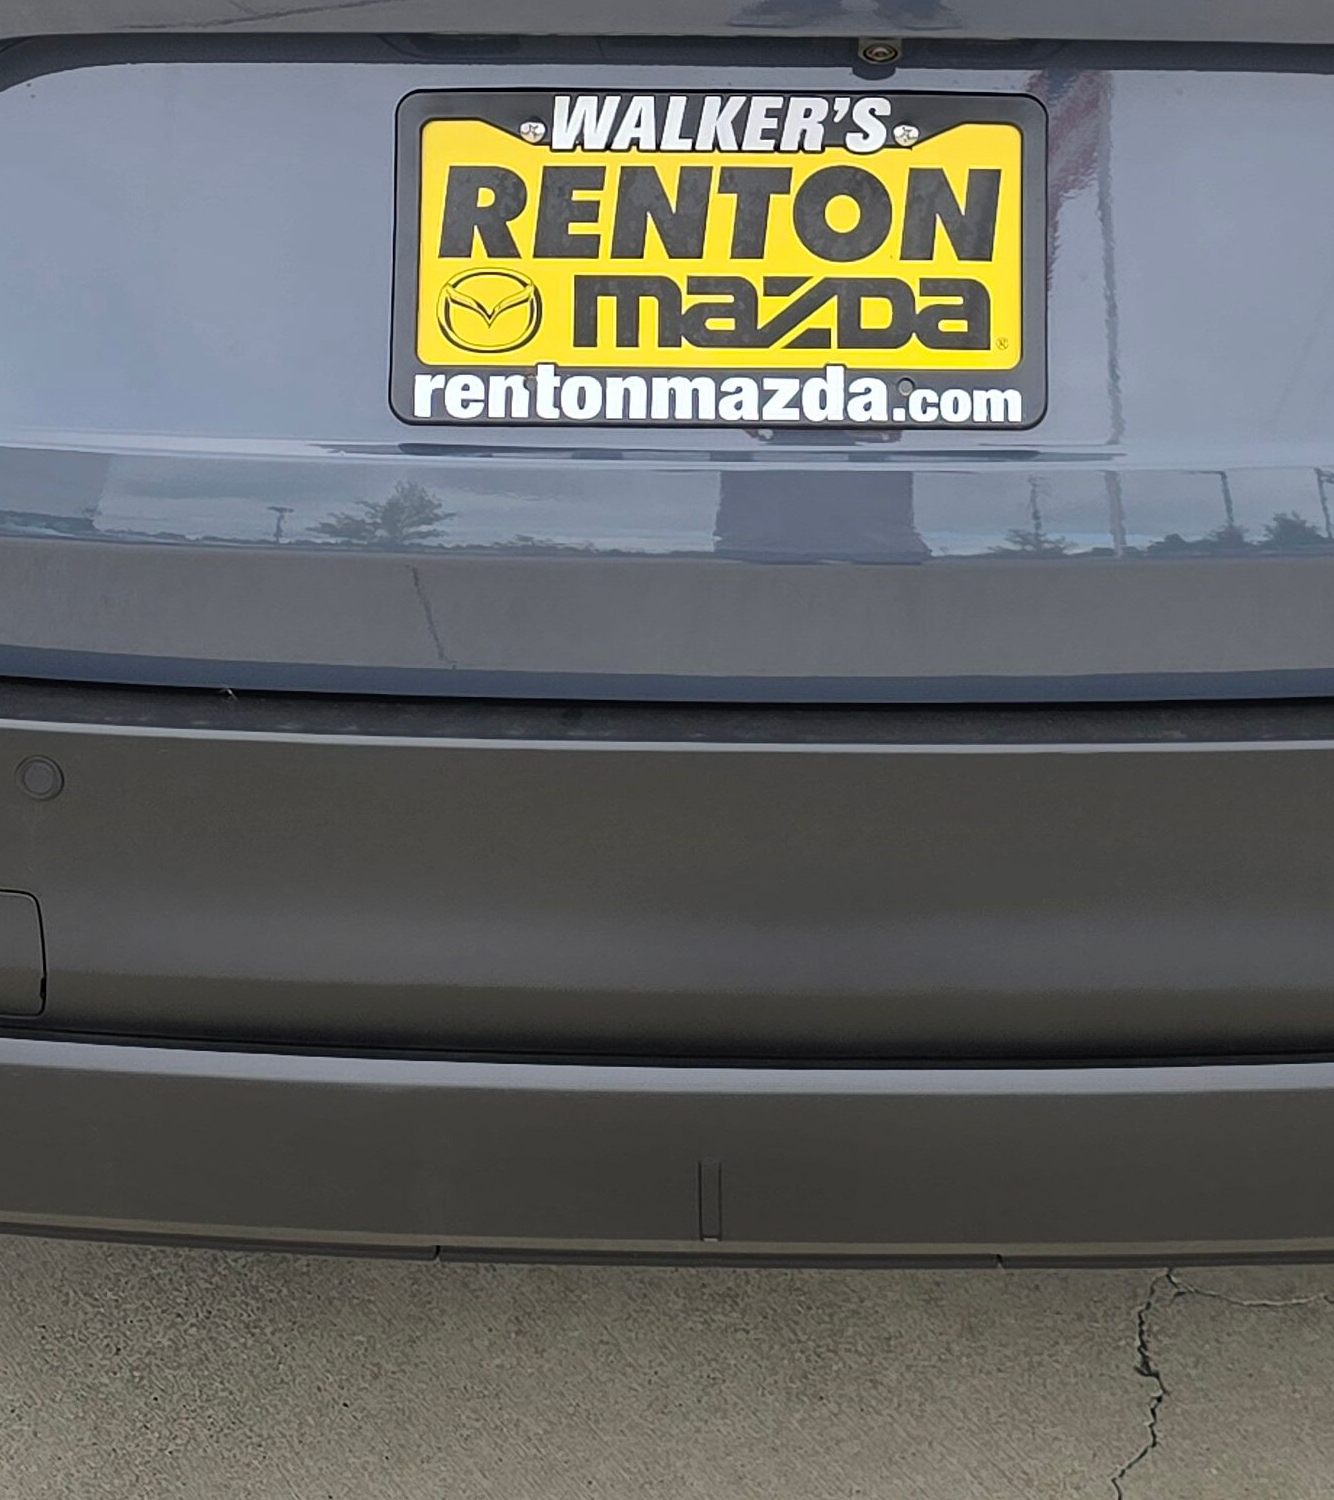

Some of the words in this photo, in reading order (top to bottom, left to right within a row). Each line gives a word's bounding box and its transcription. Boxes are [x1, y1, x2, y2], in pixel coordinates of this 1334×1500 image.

[551, 94, 893, 153] WALKER'S
[437, 164, 1003, 263] RENTON
[413, 364, 1024, 424] rentonmazda.com
